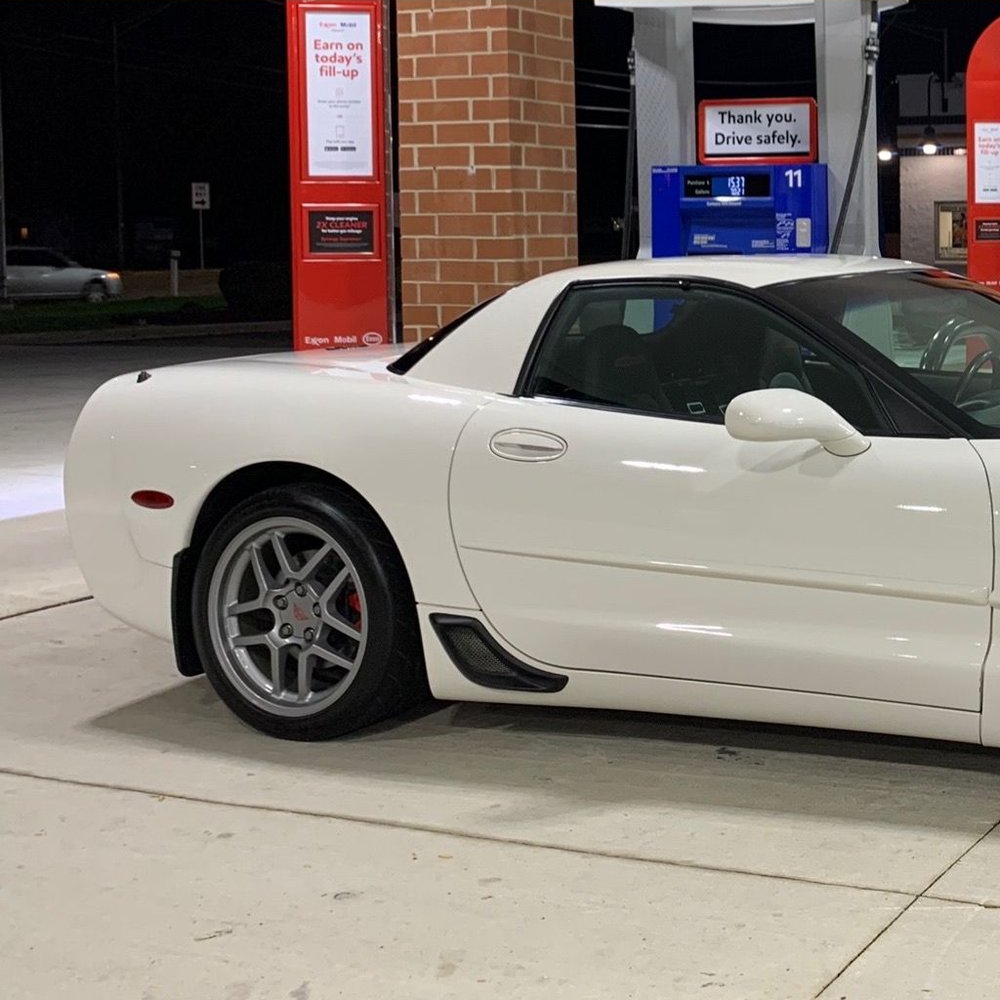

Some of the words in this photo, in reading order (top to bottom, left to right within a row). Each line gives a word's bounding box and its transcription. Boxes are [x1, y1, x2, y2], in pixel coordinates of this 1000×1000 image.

[313, 39, 343, 50] Earn
[347, 42, 363, 50] on
[314, 53, 362, 66] today's
[319, 65, 359, 80] fill-up
[718, 110, 762, 124] Thank
[766, 112, 797, 127] you.
[715, 131, 752, 145] Drive
[756, 130, 801, 147] safely.
[785, 169, 803, 189] 11
[304, 336, 330, 346] Exxon
[334, 335, 357, 344] Mobil
